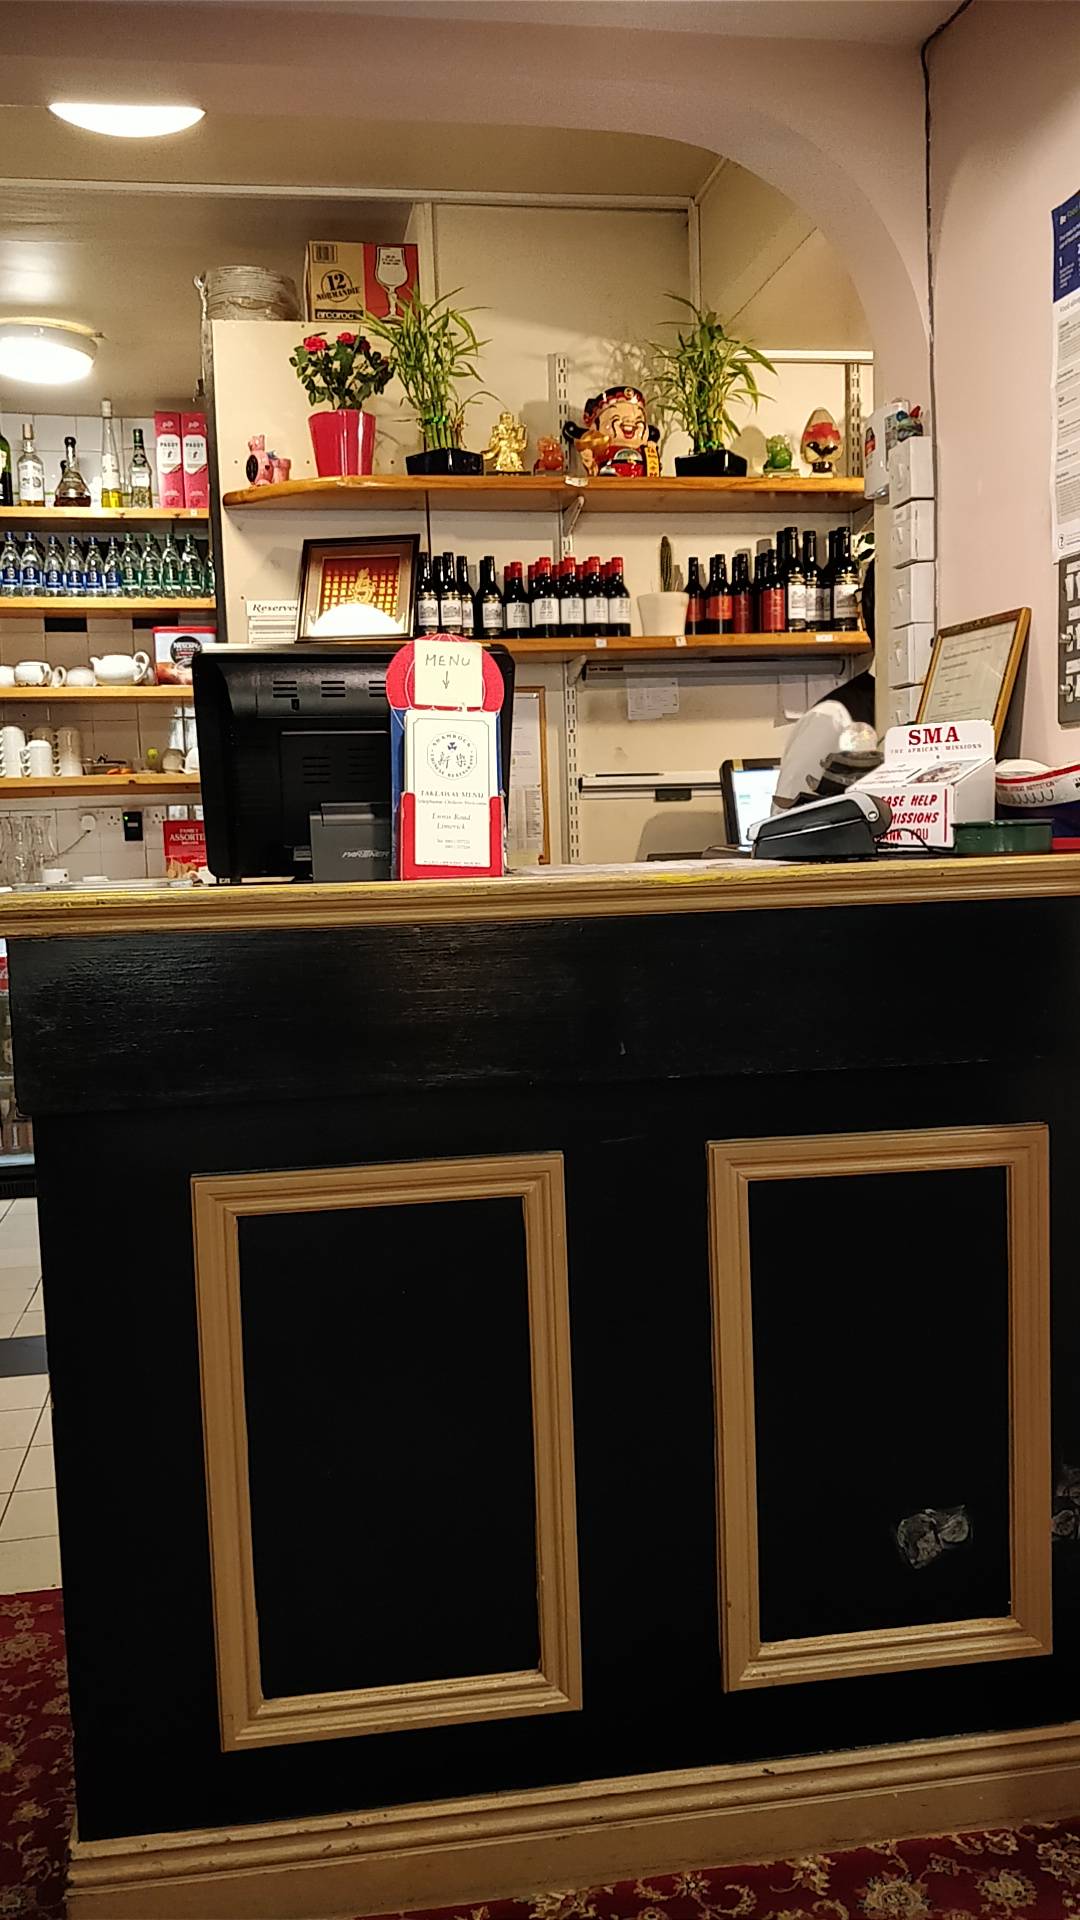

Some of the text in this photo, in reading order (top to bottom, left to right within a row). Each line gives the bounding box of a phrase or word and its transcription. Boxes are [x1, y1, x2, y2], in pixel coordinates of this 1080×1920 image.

[327, 273, 347, 291] 12
[316, 286, 361, 301] NORMANDIE
[316, 311, 356, 320] arcoroc
[425, 653, 471, 667] MENU
[908, 726, 961, 746] SMA
[907, 745, 939, 754] AFRICAN
[945, 743, 983, 752] MISSIONS
[911, 794, 938, 807] HELP
[169, 833, 205, 841] ASSORTE
